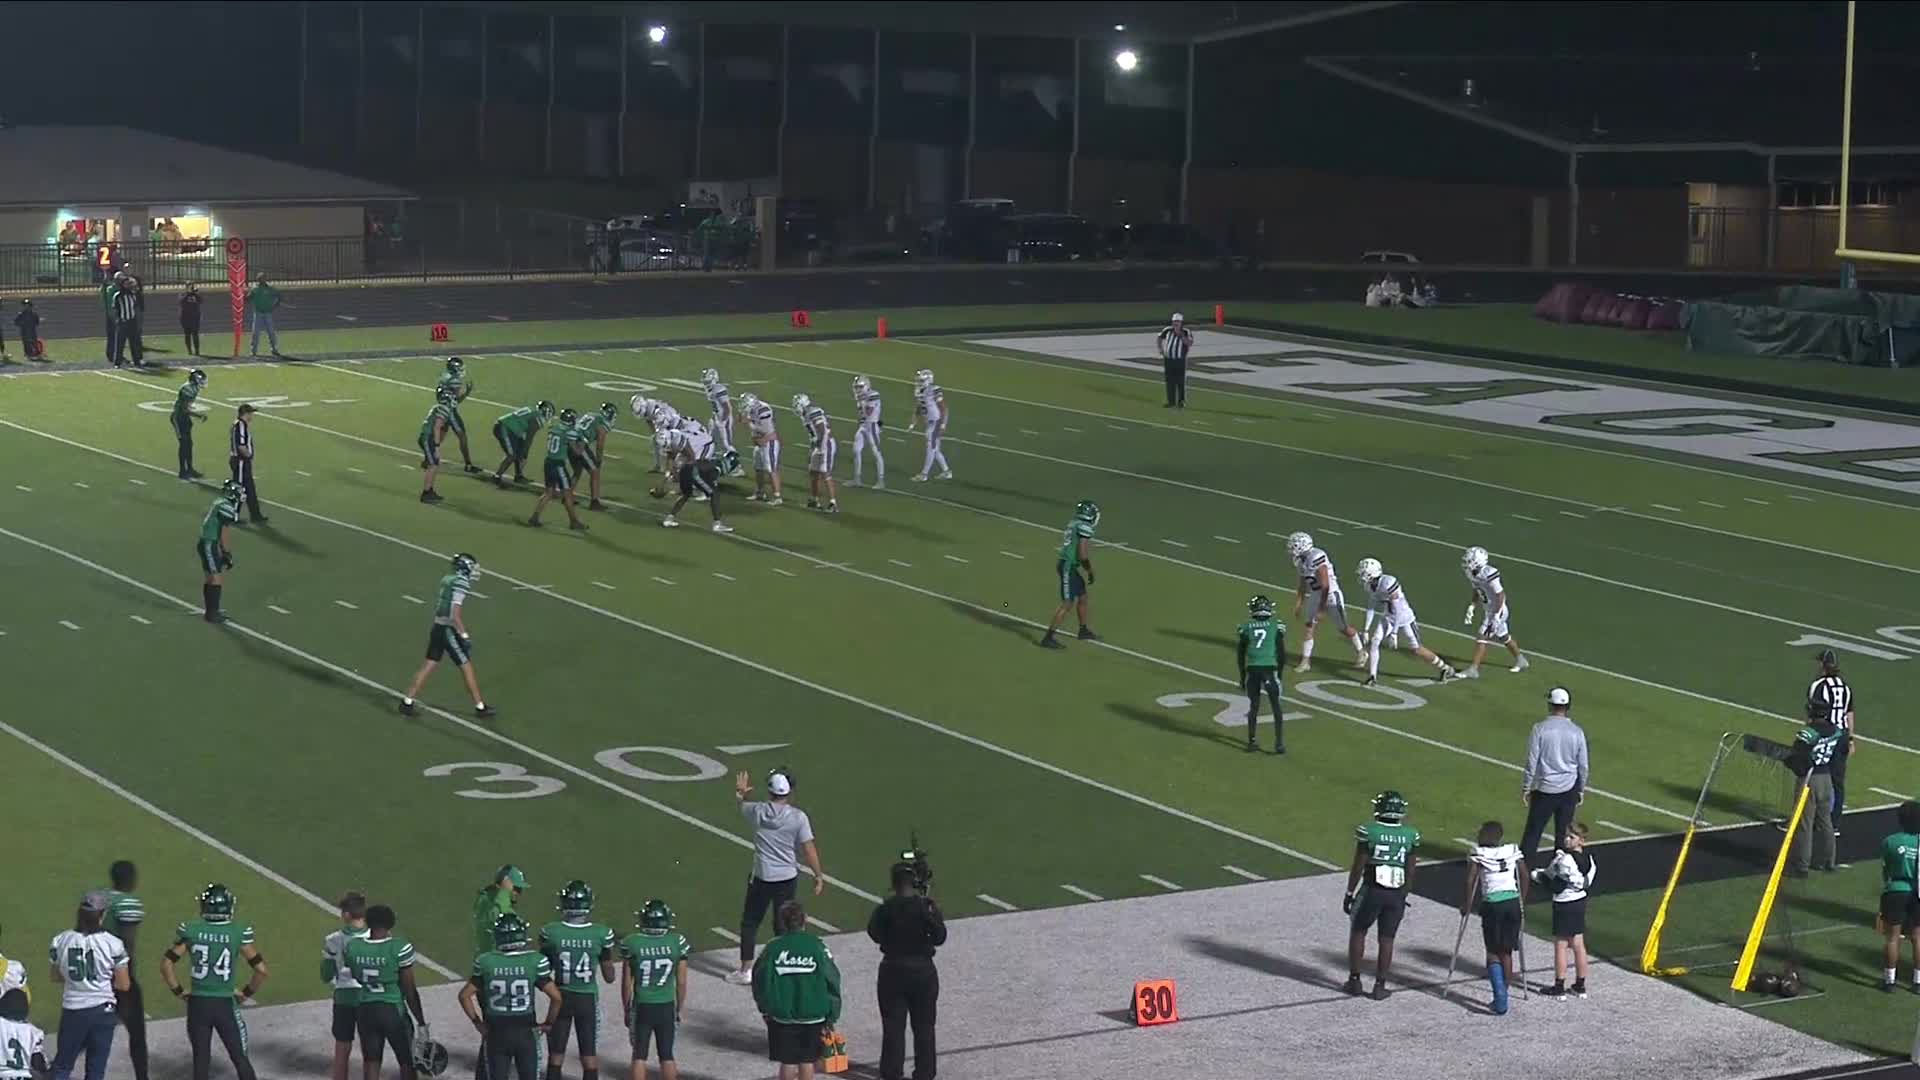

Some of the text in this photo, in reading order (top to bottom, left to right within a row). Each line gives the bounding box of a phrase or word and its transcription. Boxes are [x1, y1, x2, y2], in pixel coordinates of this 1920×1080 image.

[100, 246, 110, 264] 2
[1254, 629, 1267, 648] 7
[1156, 680, 1428, 727] 20
[423, 746, 728, 799] 30
[198, 932, 230, 943] EAGLES
[561, 939, 593, 948] EAGLES
[640, 946, 672, 956] EAGLES
[68, 947, 97, 982] 51
[191, 944, 232, 981] 34
[494, 967, 525, 976] EAGLES
[559, 952, 593, 984] 14
[639, 958, 673, 987] 17
[775, 950, 814, 966] Moses
[1140, 986, 1173, 1020] 30
[6, 1038, 24, 1070] 3
